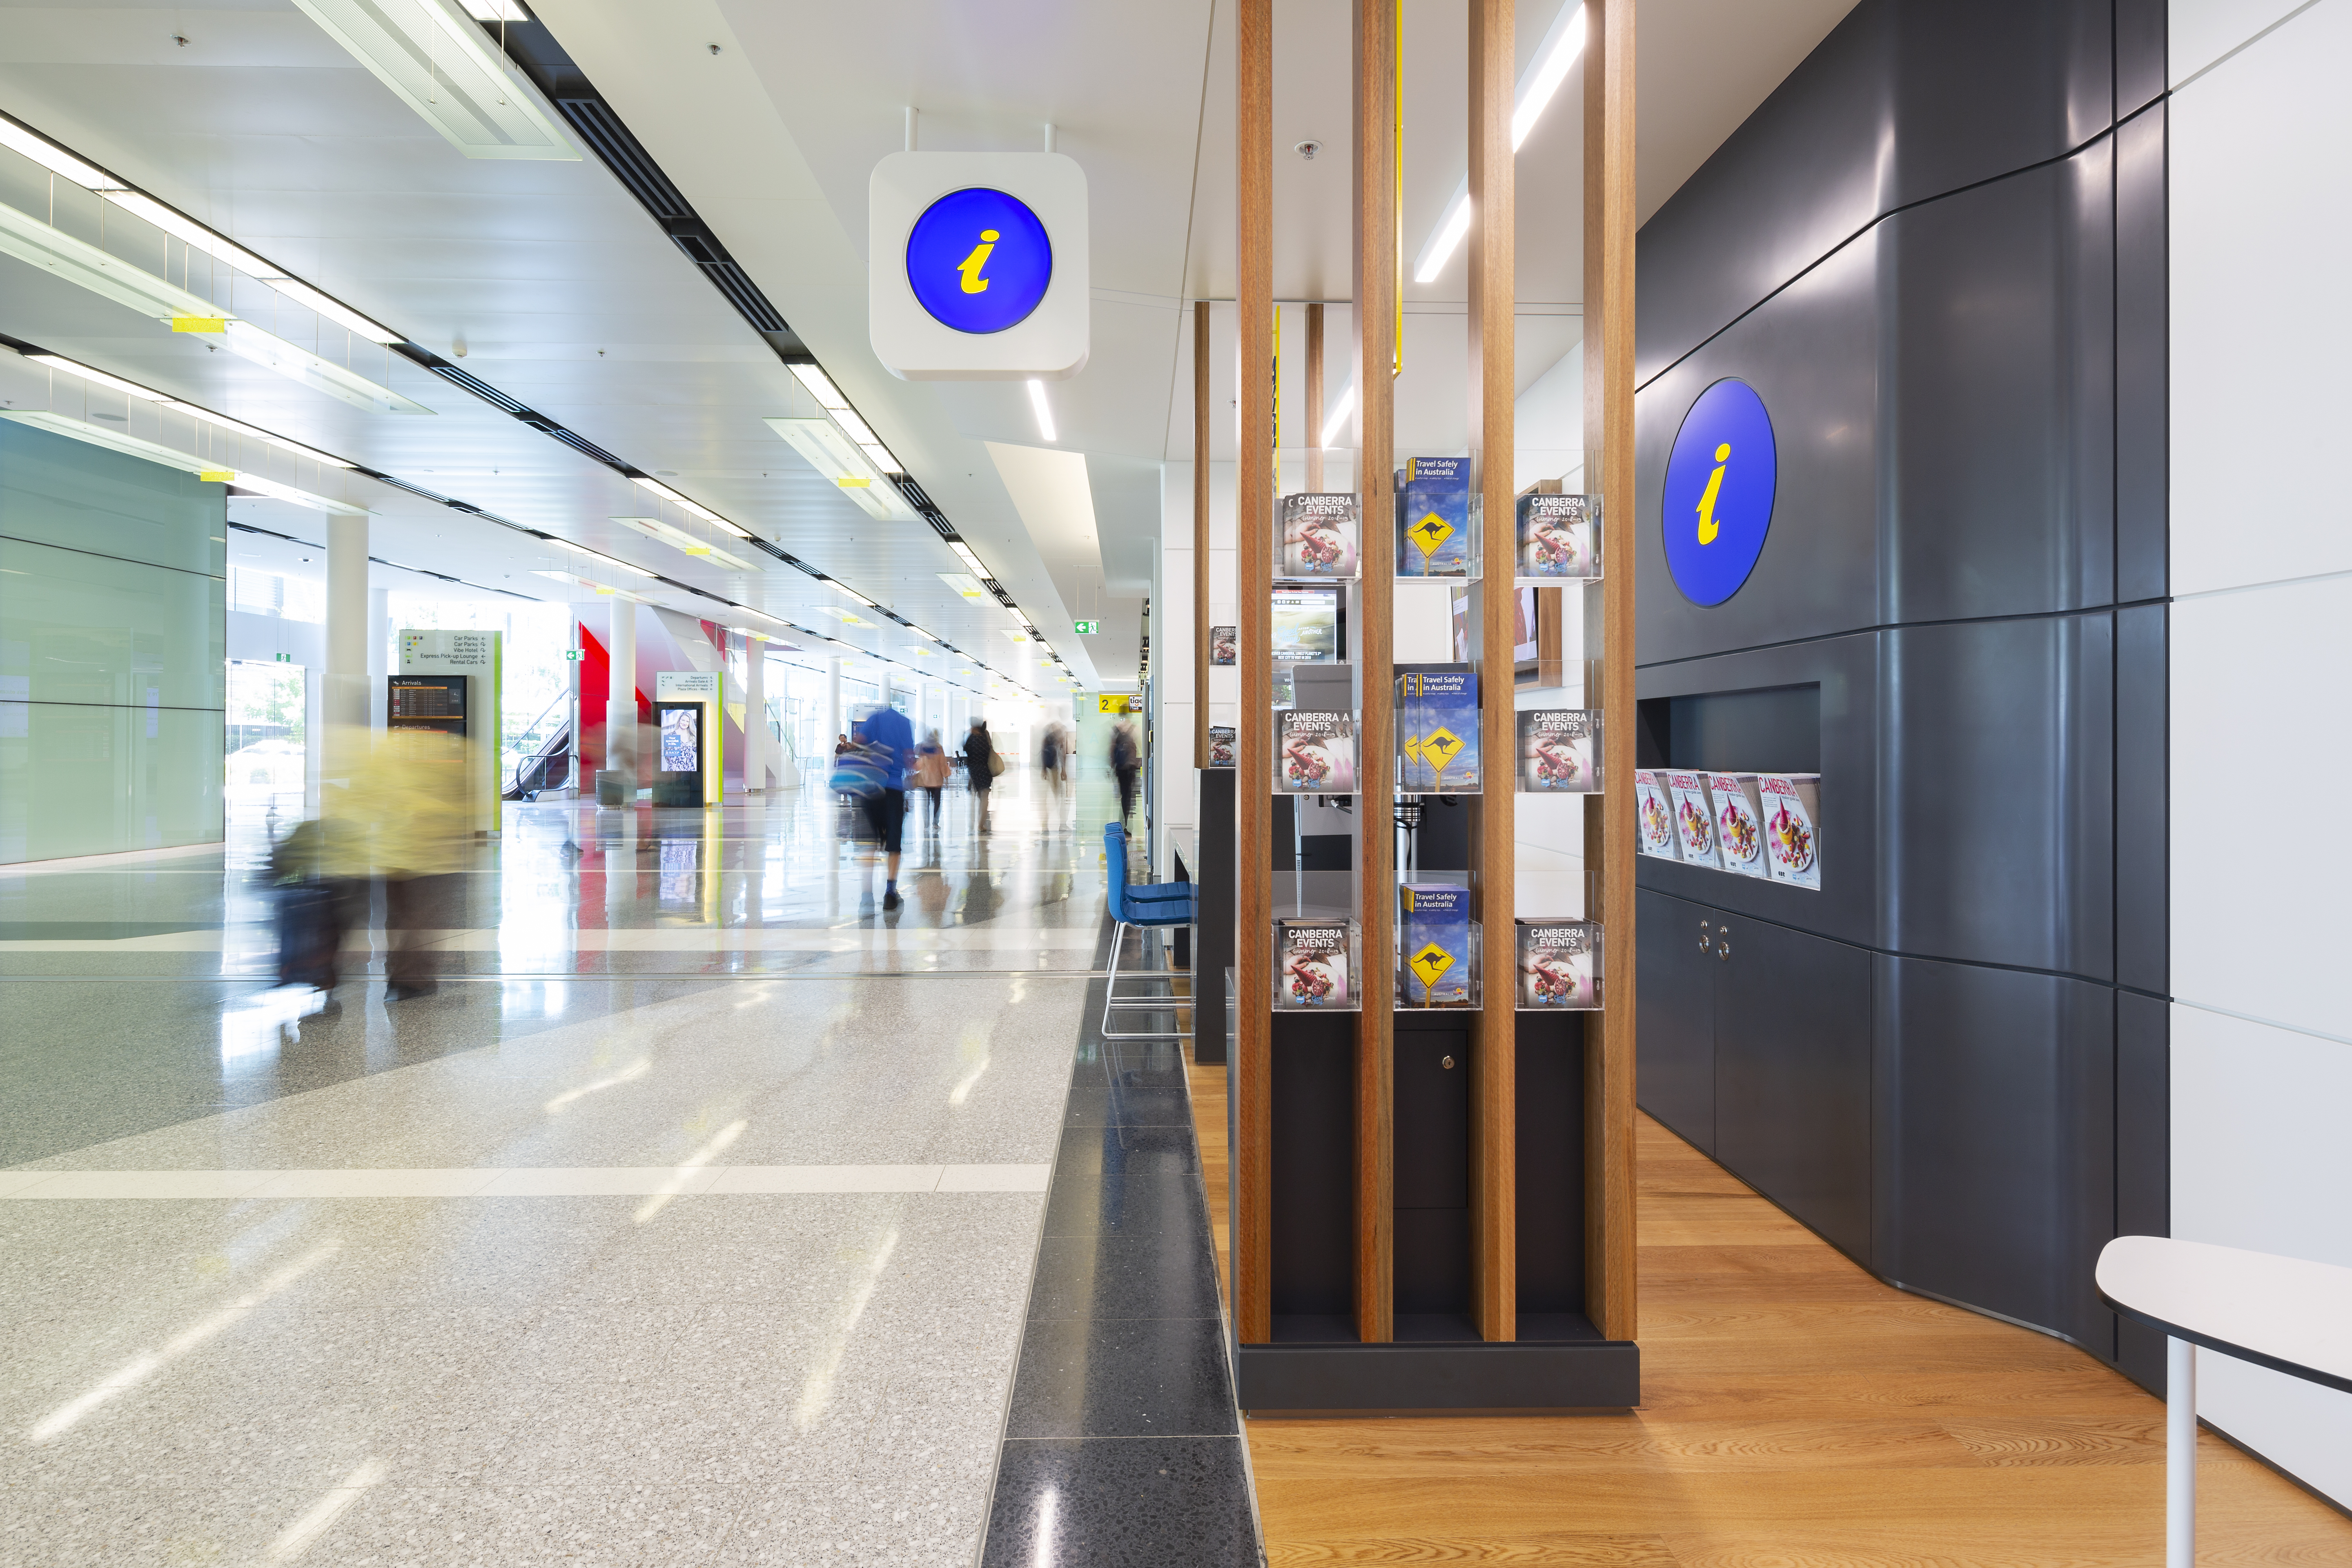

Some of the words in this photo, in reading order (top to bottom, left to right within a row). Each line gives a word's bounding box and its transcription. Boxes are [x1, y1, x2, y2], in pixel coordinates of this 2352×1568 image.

[1437, 460, 1458, 469] Safely
[1298, 496, 1352, 506] CANBERRA
[1532, 497, 1586, 506] CANBERRA
[1306, 505, 1344, 514] EVENTS
[1540, 507, 1577, 515] EVENTS
[1444, 676, 1464, 685] Safely
[1102, 699, 1109, 710] 2
[1130, 697, 1143, 706] tige
[1285, 713, 1339, 722] CANBERRA
[1534, 713, 1587, 722] CANBERRA
[1294, 722, 1331, 731] EVENTS
[1542, 722, 1579, 731] EVENTS
[1635, 771, 1659, 787] CANBERRA
[1668, 774, 1700, 790] CANBERRA
[1708, 775, 1744, 794] CANBERRA
[1759, 777, 1798, 797] CANBERRA
[1437, 893, 1457, 902] Safely
[1289, 929, 1343, 938] CANBERRA
[1531, 929, 1585, 938] CANBERRA
[1297, 939, 1334, 947] EVENTS
[1539, 938, 1577, 947] EVENTS
